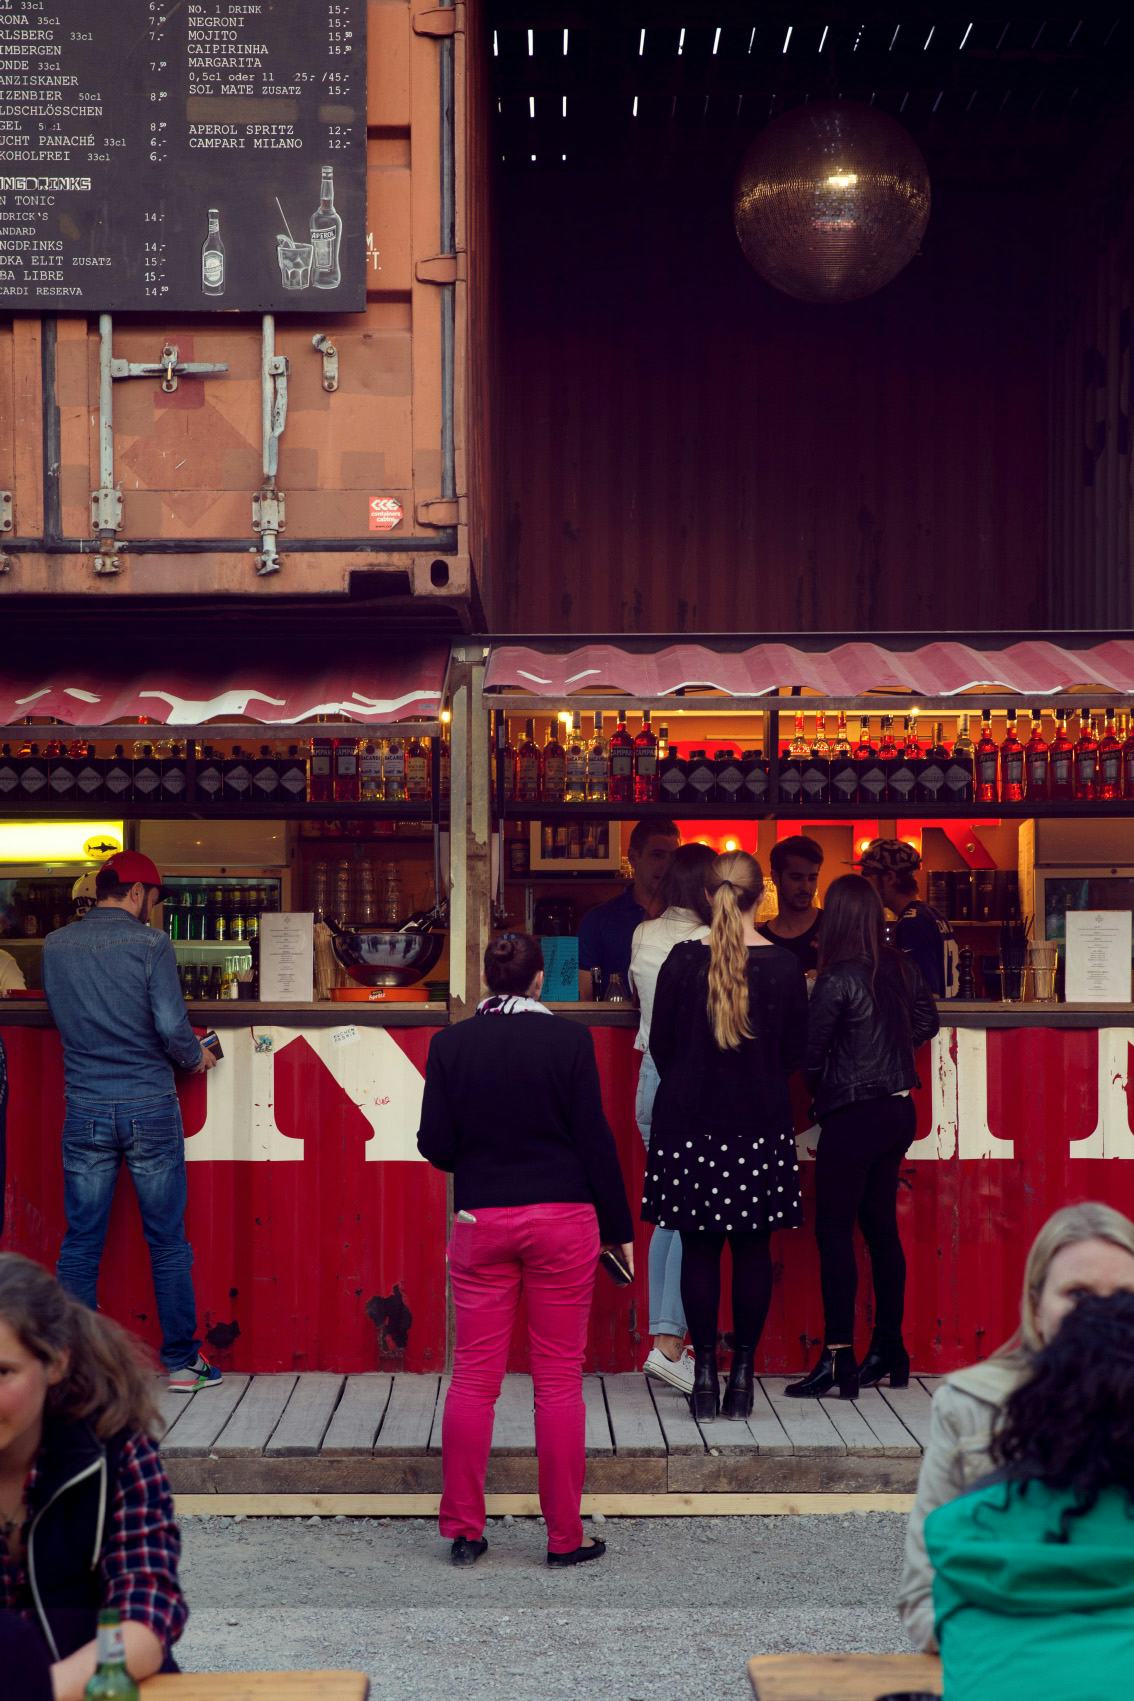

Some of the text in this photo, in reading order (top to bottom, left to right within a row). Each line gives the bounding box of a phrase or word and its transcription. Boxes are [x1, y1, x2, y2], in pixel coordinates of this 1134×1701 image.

[20, 2, 44, 10] 33cl
[149, 2, 164, 10] 6.-
[188, 4, 208, 14] NO.
[228, 4, 262, 14] DRINK
[328, 5, 350, 14] 15.-
[36, 16, 61, 25] 35cl
[188, 17, 350, 28] NEGRONI 15.-
[70, 32, 94, 41] 33cl
[149, 32, 164, 41] 7.-
[188, 30, 238, 41] MOJITO
[187, 44, 269, 54] CAIPIRINHA
[38, 62, 61, 71] 33cl
[188, 57, 262, 68] MARGARITA
[228, 72, 255, 82] oder
[188, 84, 350, 95] SOL MATE ZUSATZ 15.-
[78, 92, 102, 101] 50cl
[188, 124, 352, 135] APEROL SPRITZ 12.-
[38, 134, 95, 146] PANACHÉ
[103, 138, 127, 146] 33cl
[150, 138, 167, 147] 6.-
[188, 138, 351, 149] CAMPARI MILANO 12.-
[87, 153, 111, 161] 33cl
[149, 152, 168, 162] 6.-
[14, 196, 56, 206] TONIC
[144, 212, 166, 222] 14.-
[144, 242, 167, 252] 14.-
[30, 256, 64, 266] ELIT
[72, 258, 112, 266] ZUSATZ
[23, 270, 64, 281] LIBRE
[36, 287, 84, 296] RESERVA
